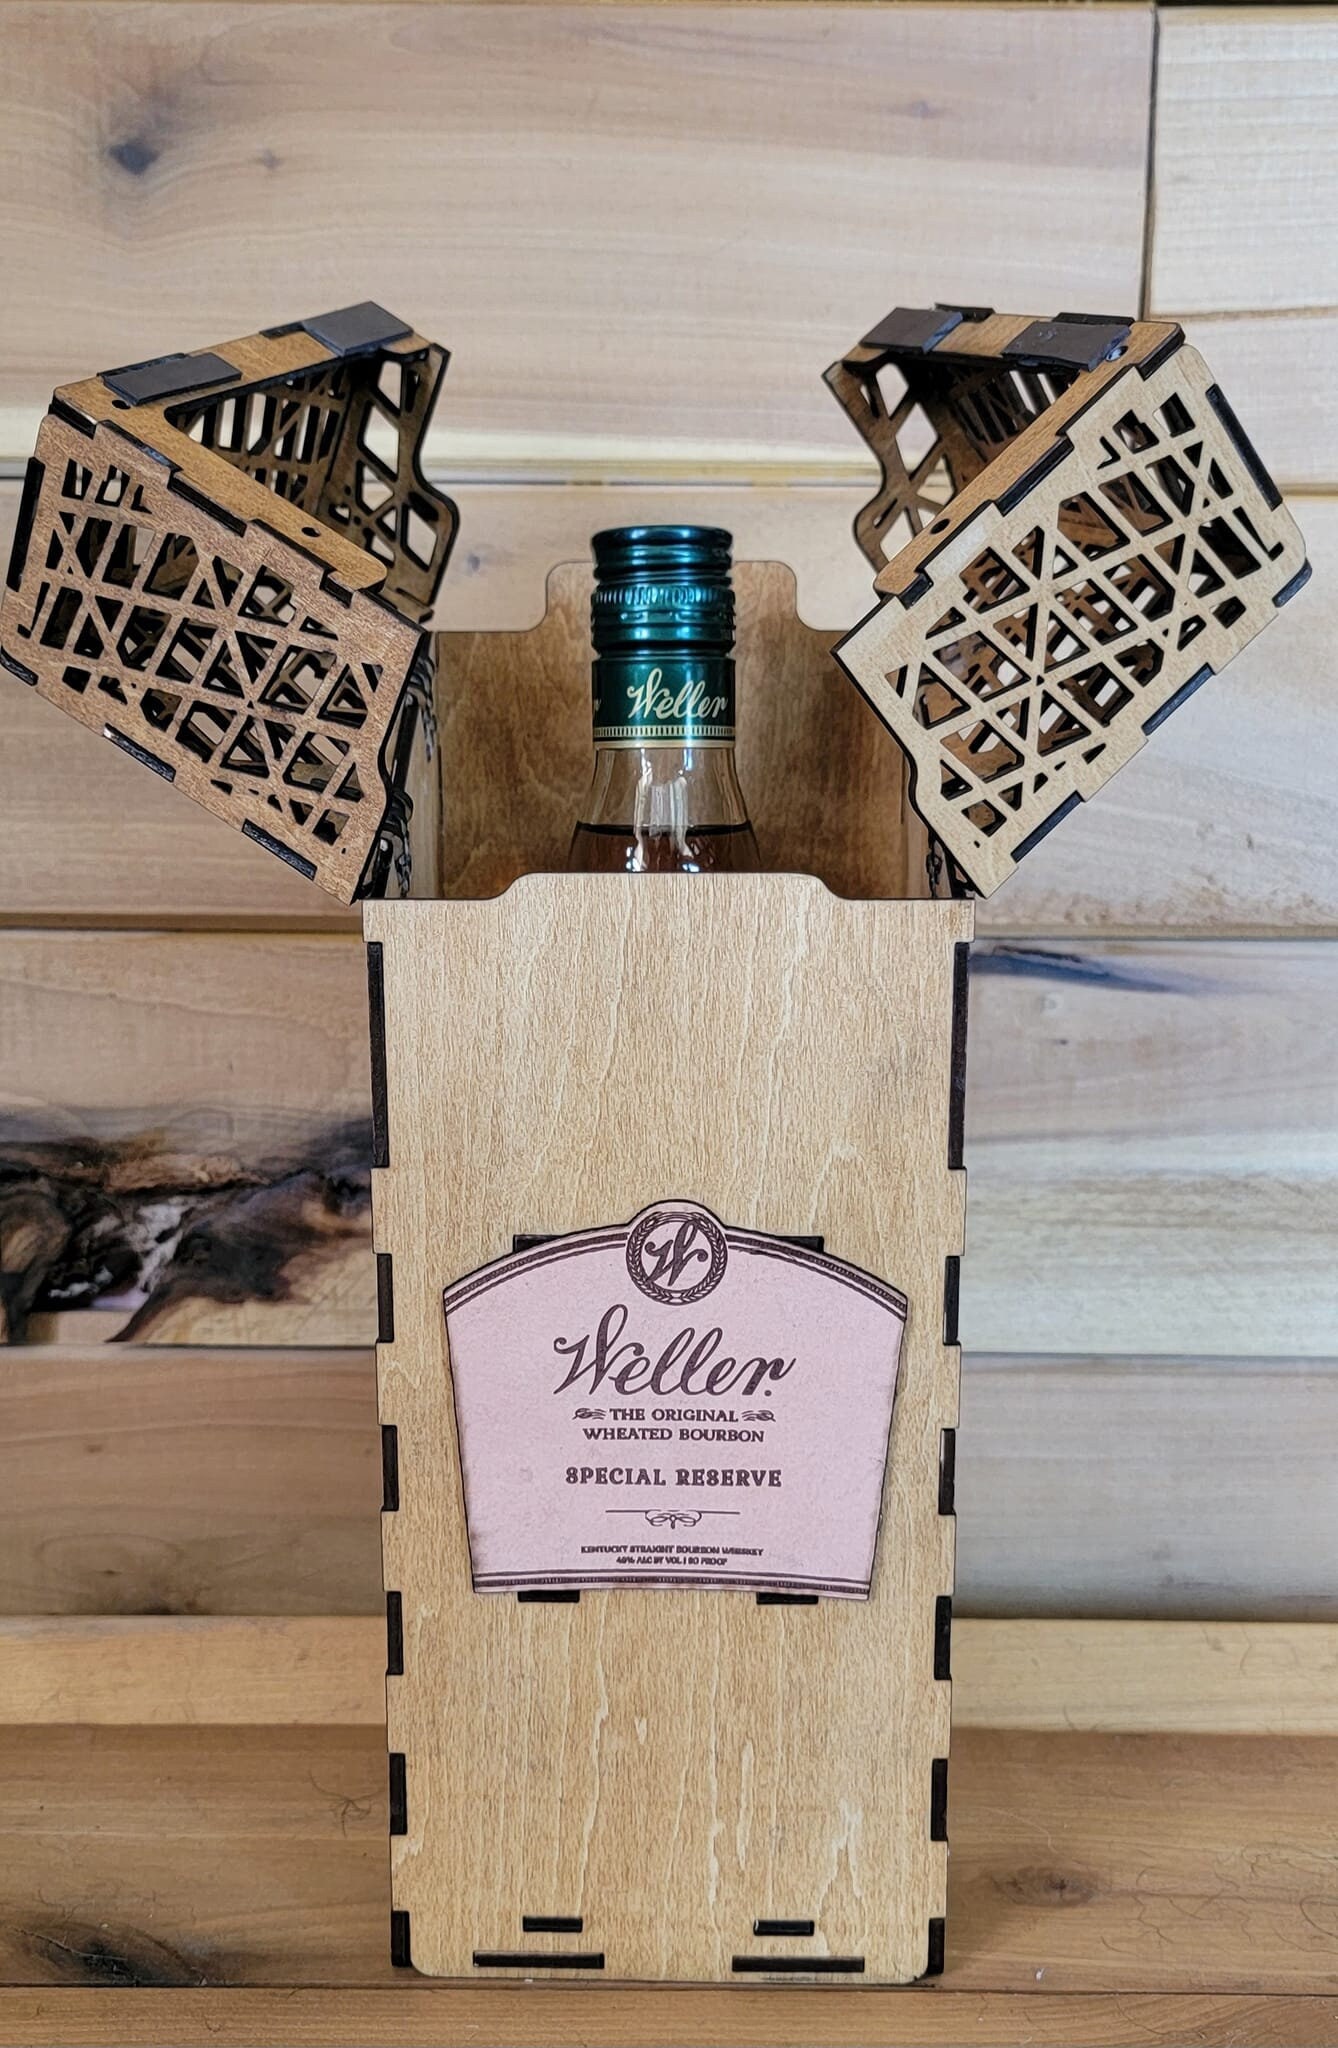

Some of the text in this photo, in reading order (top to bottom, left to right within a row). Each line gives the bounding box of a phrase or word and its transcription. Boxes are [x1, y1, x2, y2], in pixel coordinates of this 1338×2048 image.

[626, 667, 728, 720] Weller
[609, 1408, 739, 1422] THE ORIGINAL
[583, 1427, 765, 1442] WHEATED BOURBON
[565, 1466, 782, 1487] SPECIAL RESERVE
[581, 1545, 627, 1554] KENTUCKY
[629, 1545, 675, 1554] STRAIGHT
[676, 1546, 720, 1555] BOURBON
[636, 1556, 653, 1564] ALC
[653, 1556, 664, 1564] BY
[666, 1557, 682, 1565] VOL
[700, 1557, 728, 1566] PROOF
